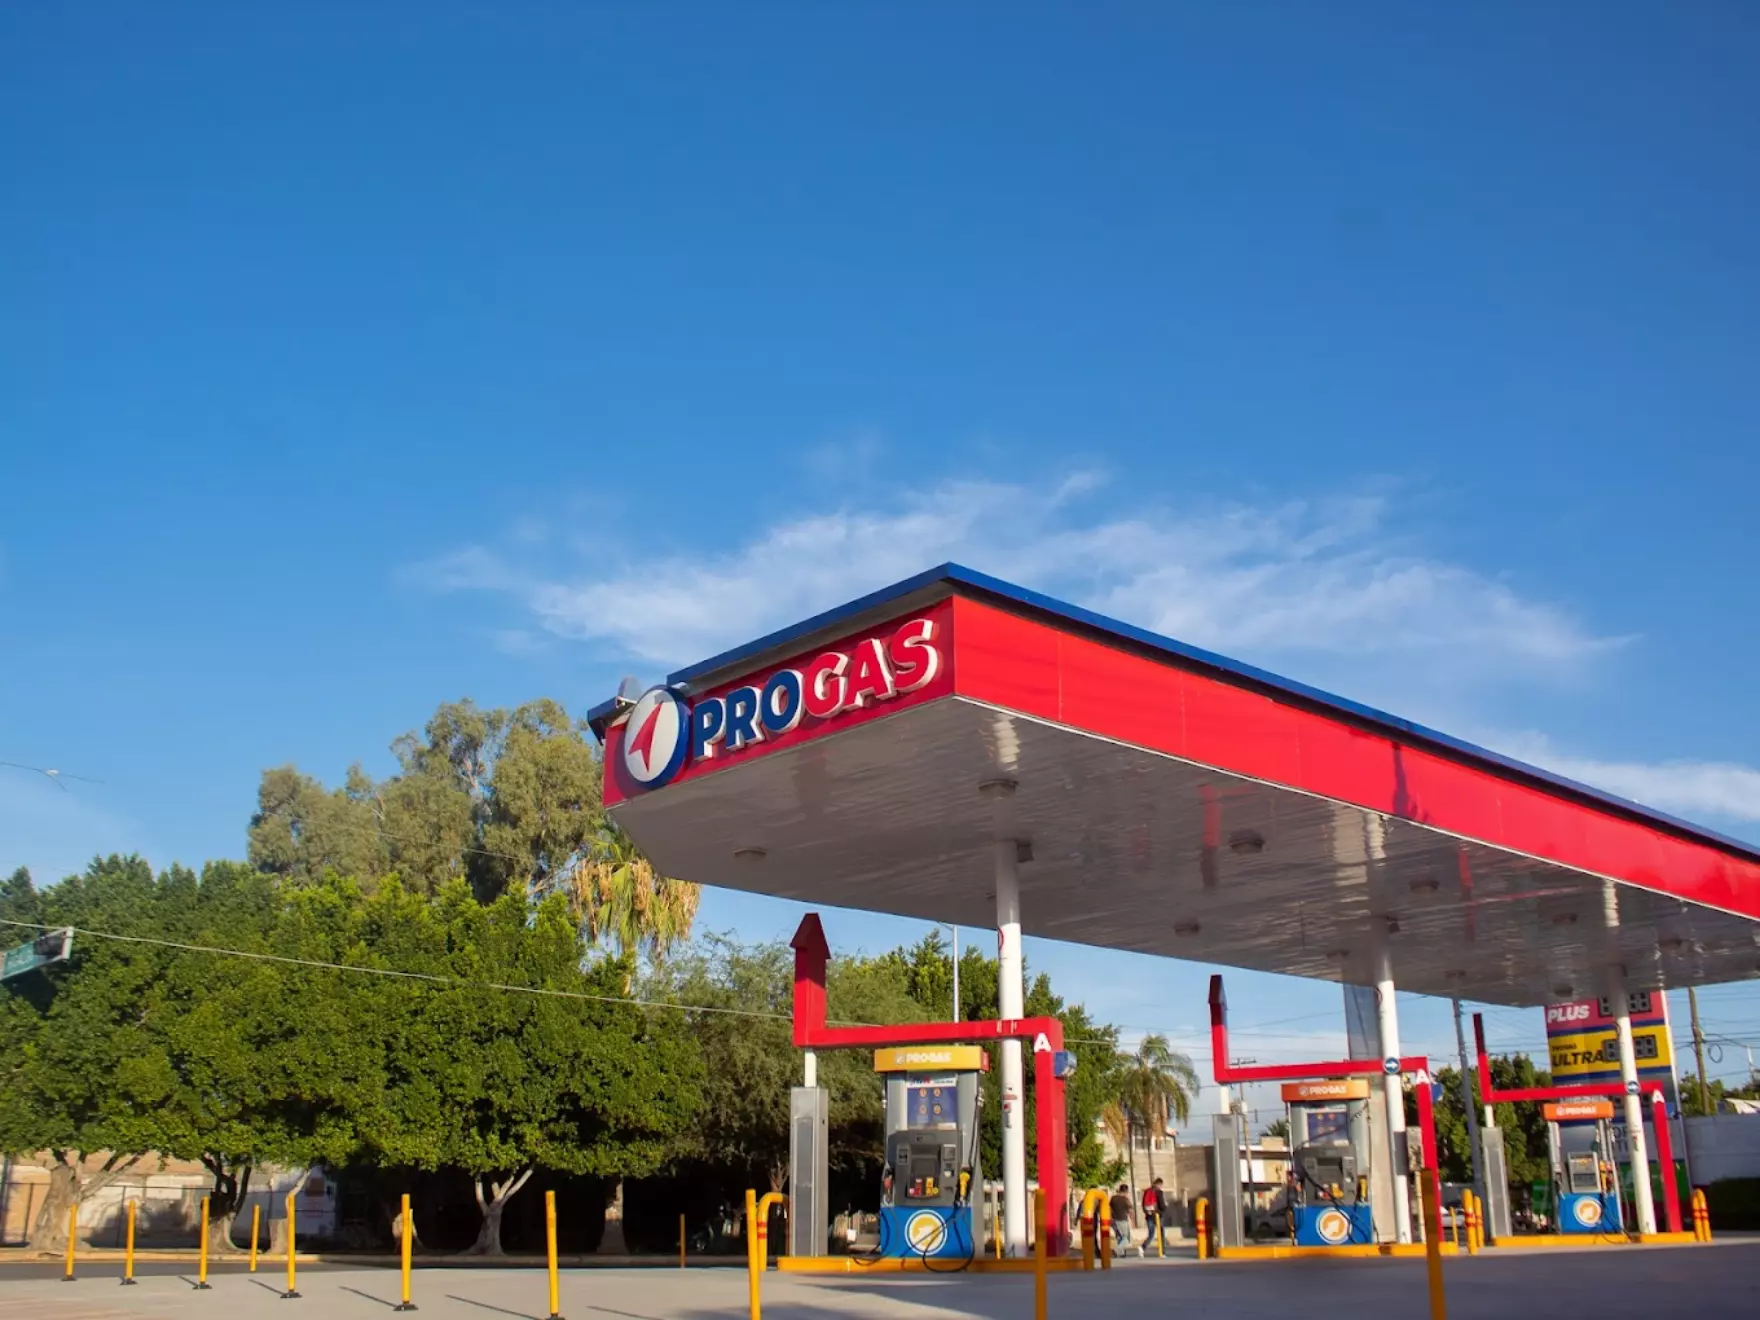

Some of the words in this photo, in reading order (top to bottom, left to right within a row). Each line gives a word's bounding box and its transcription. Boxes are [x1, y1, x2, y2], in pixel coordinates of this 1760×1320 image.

[693, 618, 938, 759] PROGAS
[1547, 1005, 1589, 1023] PLUS
[1034, 1032, 1052, 1053] A
[1552, 1049, 1604, 1067] ULTRA
[1416, 1068, 1429, 1084] A
